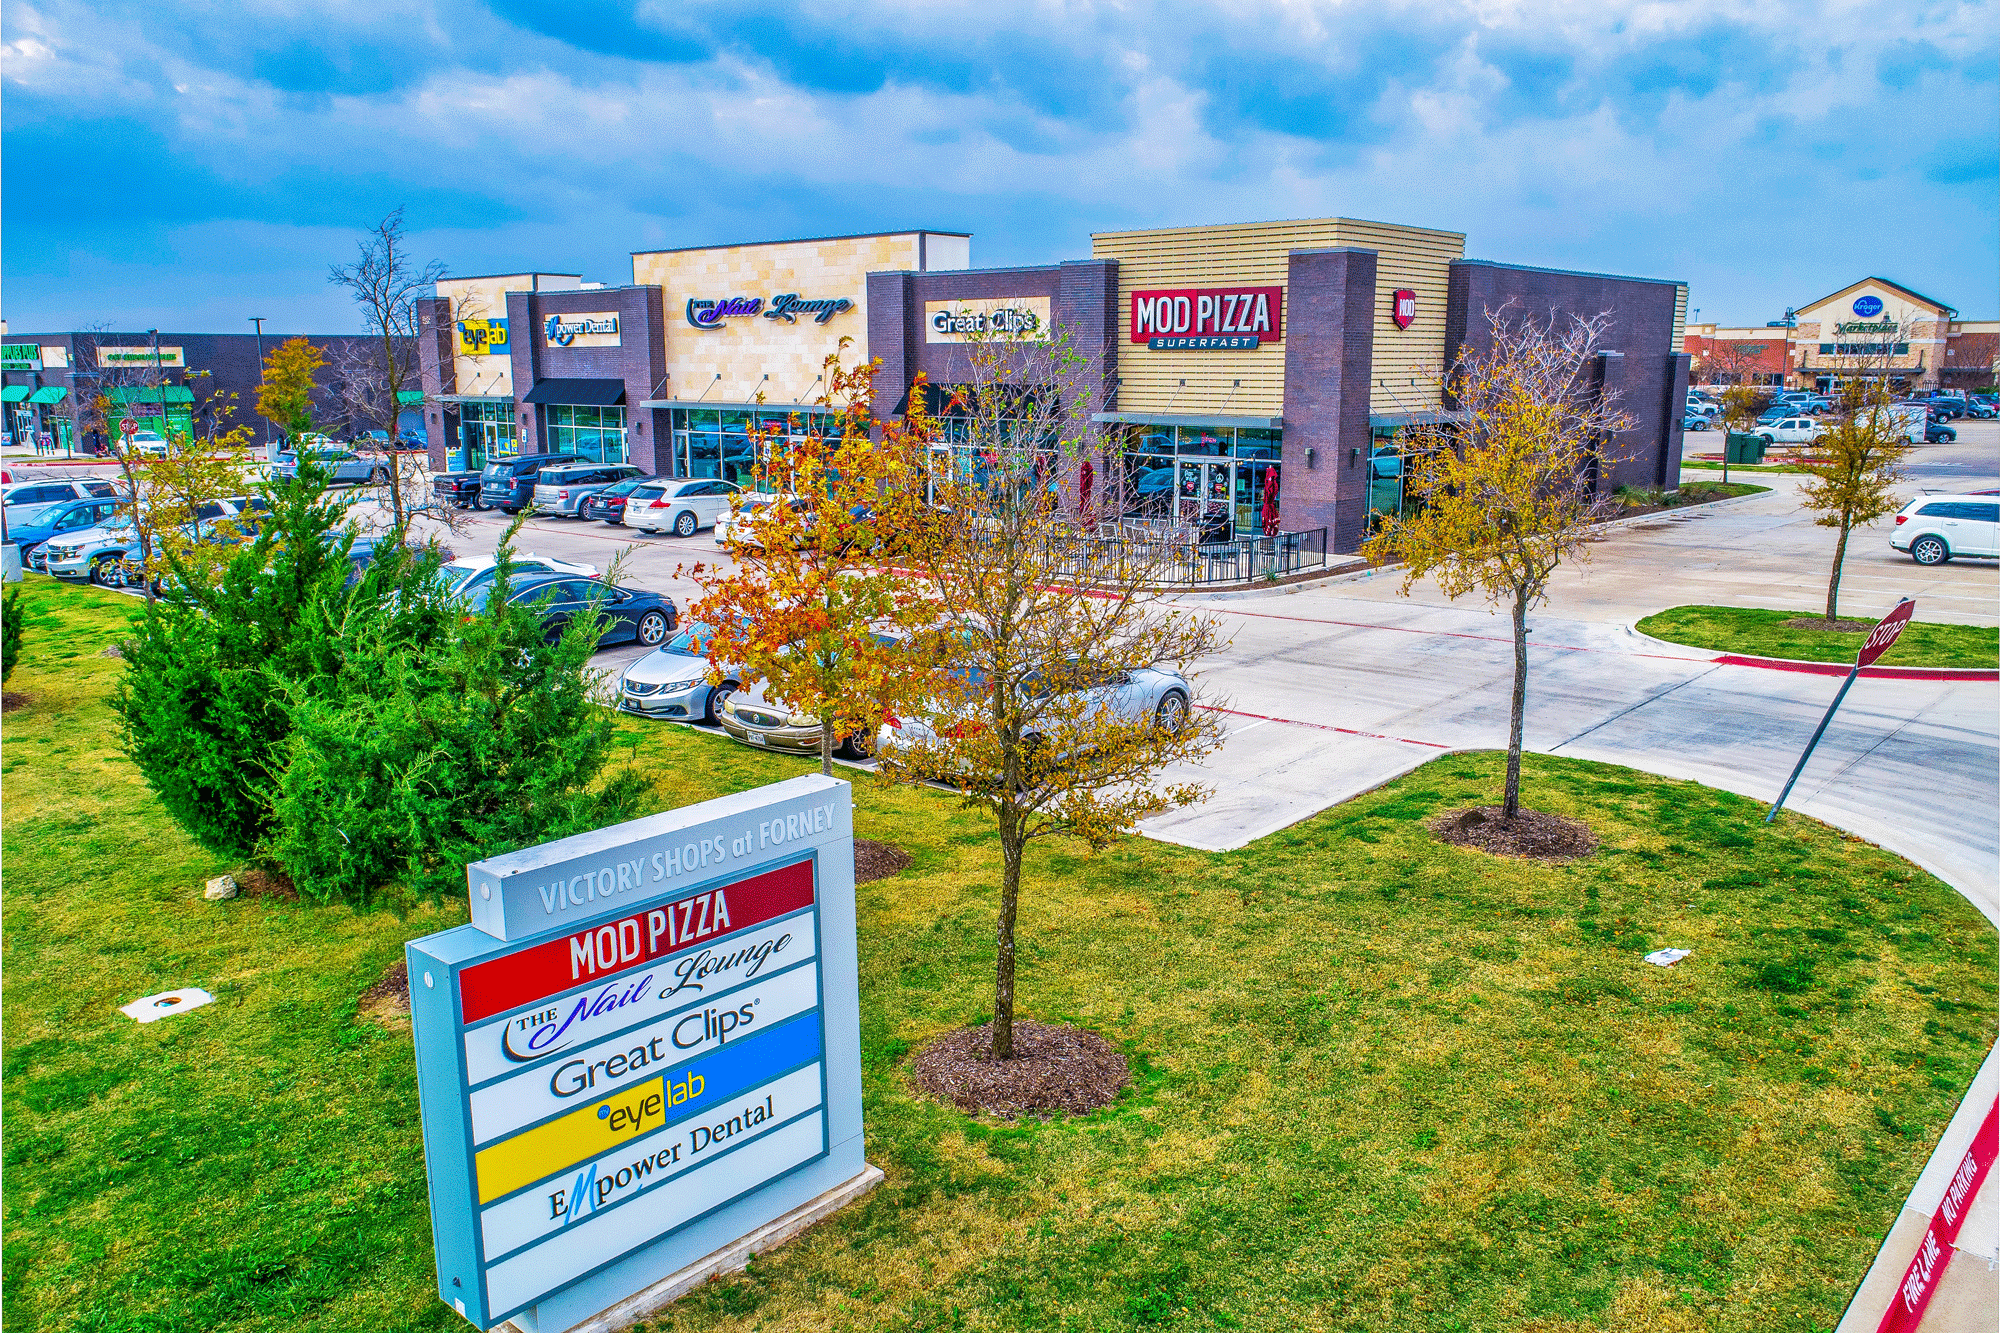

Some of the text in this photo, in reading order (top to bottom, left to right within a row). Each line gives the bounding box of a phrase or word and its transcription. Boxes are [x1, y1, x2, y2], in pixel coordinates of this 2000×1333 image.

[698, 296, 764, 324] Nail
[763, 292, 854, 326] Lounge
[932, 308, 1037, 337] Great Clips
[1137, 294, 1270, 333] MOD PIZZA
[1399, 299, 1415, 317] MOD
[1854, 299, 1882, 315] Kroger
[585, 317, 618, 334] Dental
[1157, 338, 1251, 348] SUPERFAST
[1864, 619, 1907, 649] STOP
[538, 802, 837, 915] VICTORY SHOPS at FORNEY
[570, 889, 731, 980] MOD PIZZA
[515, 932, 793, 1051] THE Nail Lounge
[549, 1036, 665, 1098] Great
[690, 1095, 775, 1156] Dental
[1902, 1151, 1978, 1313] FIRE LANE NO PARKING
